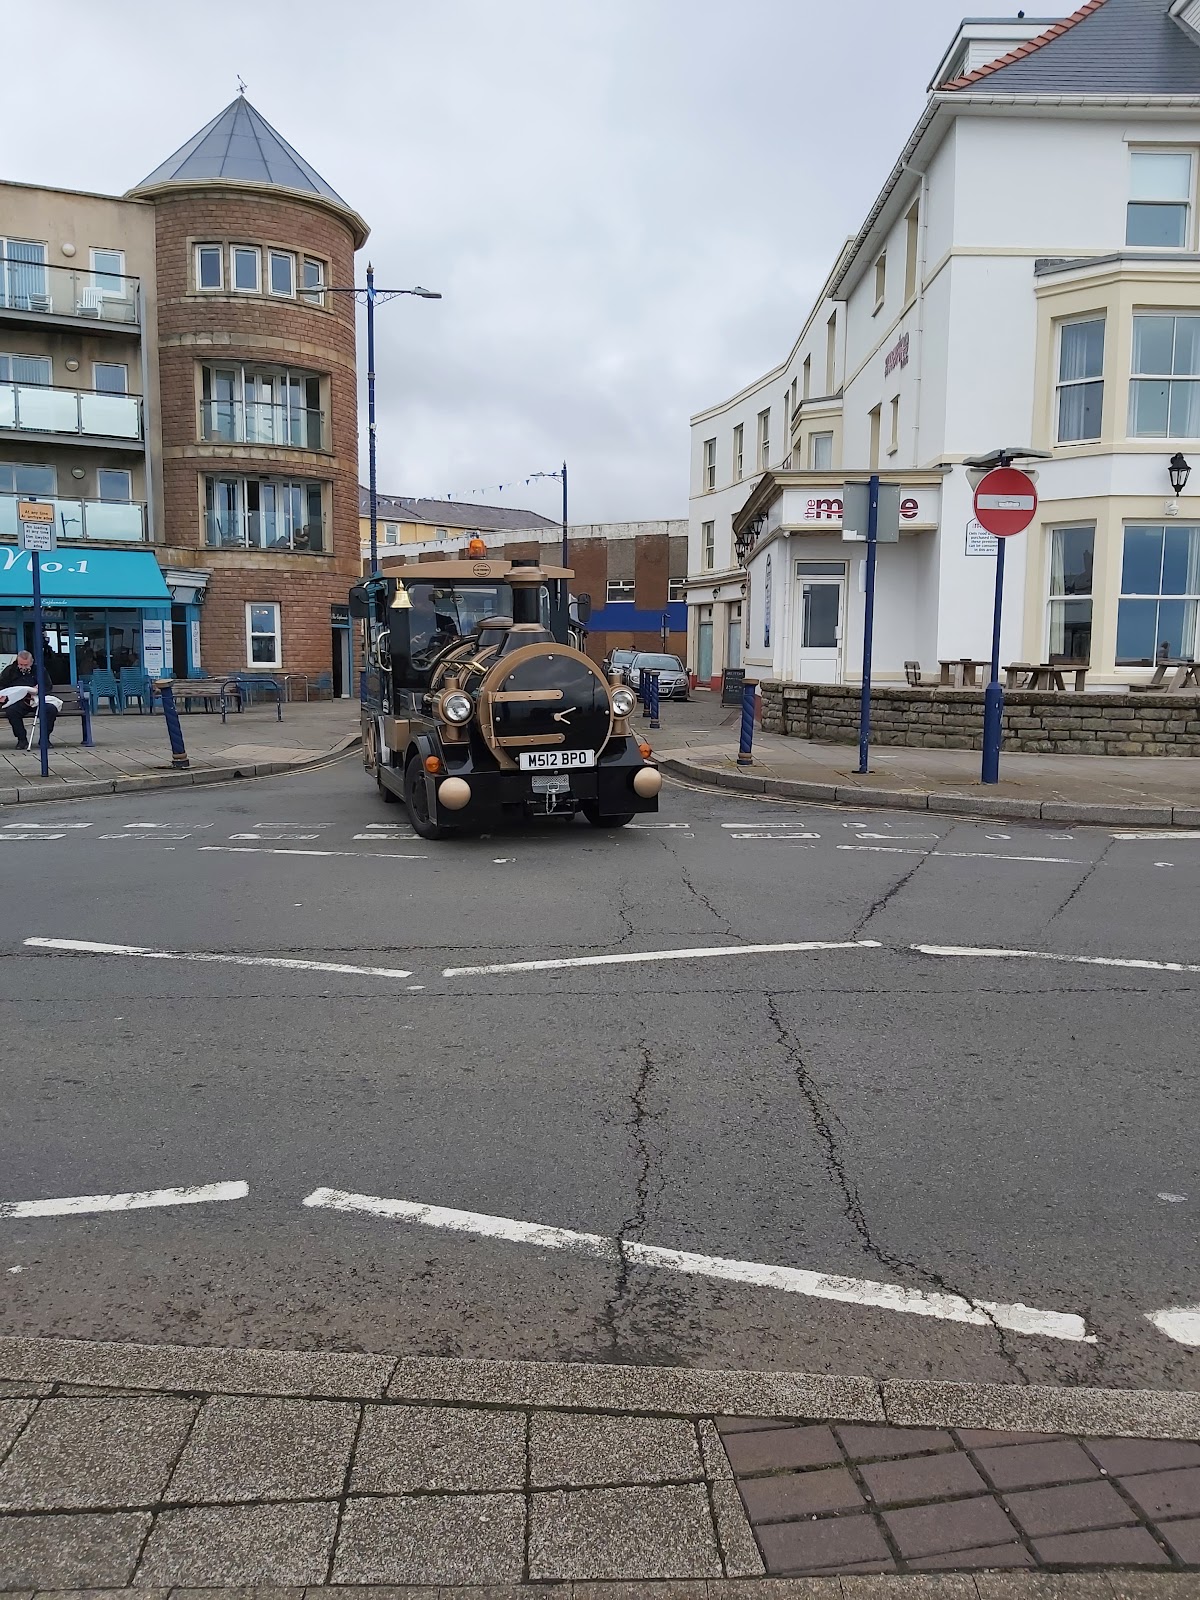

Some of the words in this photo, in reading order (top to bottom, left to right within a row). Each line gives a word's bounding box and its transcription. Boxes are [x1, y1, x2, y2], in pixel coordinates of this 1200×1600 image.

[804, 499, 816, 519] the
[528, 753, 558, 767] M512
[561, 751, 587, 765] BPO
